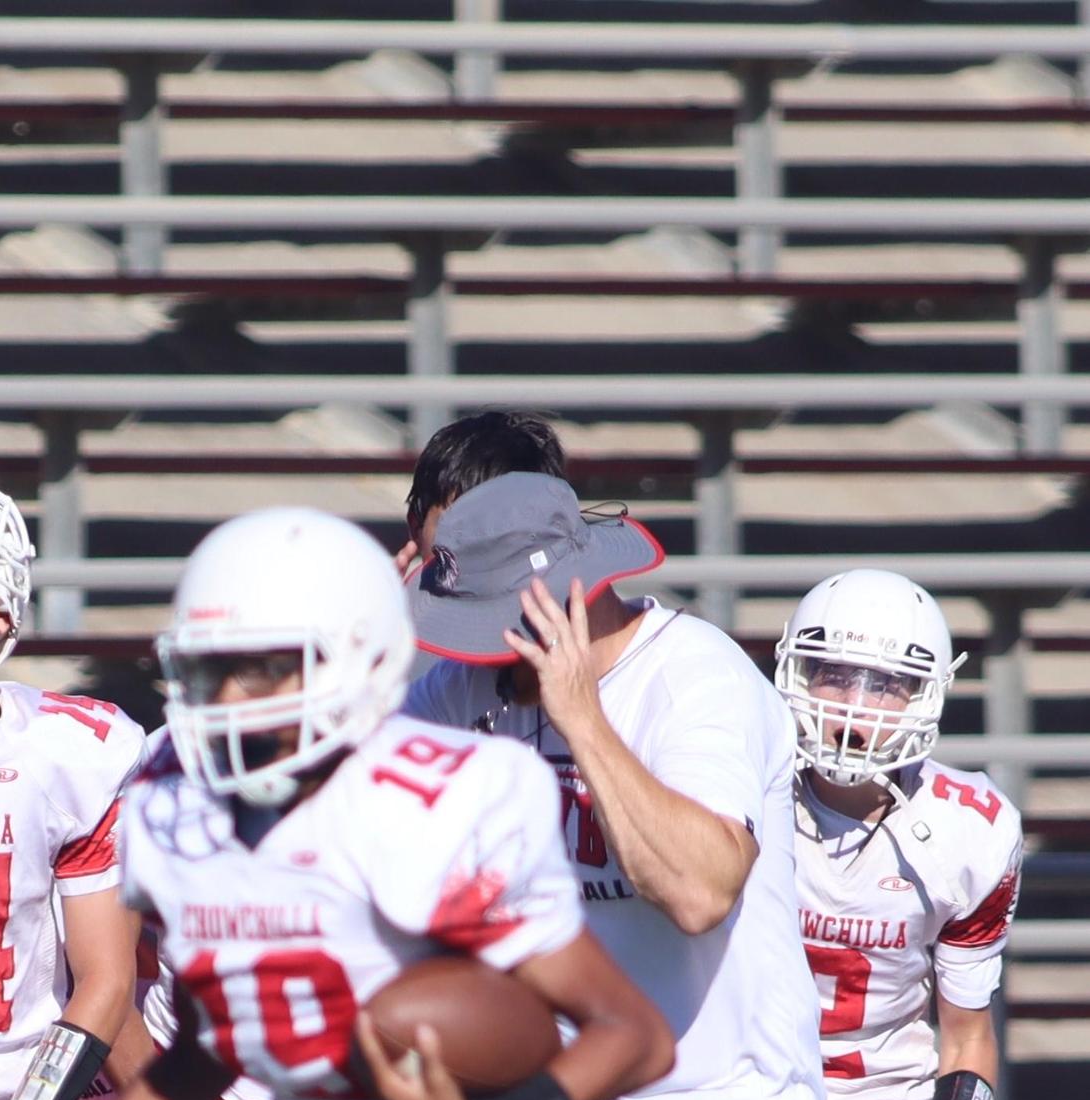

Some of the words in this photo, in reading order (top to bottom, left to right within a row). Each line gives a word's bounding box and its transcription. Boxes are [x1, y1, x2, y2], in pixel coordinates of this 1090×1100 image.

[372, 734, 477, 809] 19
[932, 773, 1002, 826] 2
[181, 904, 323, 942] CHOWCHILLA
[798, 909, 907, 949] WCHILLA
